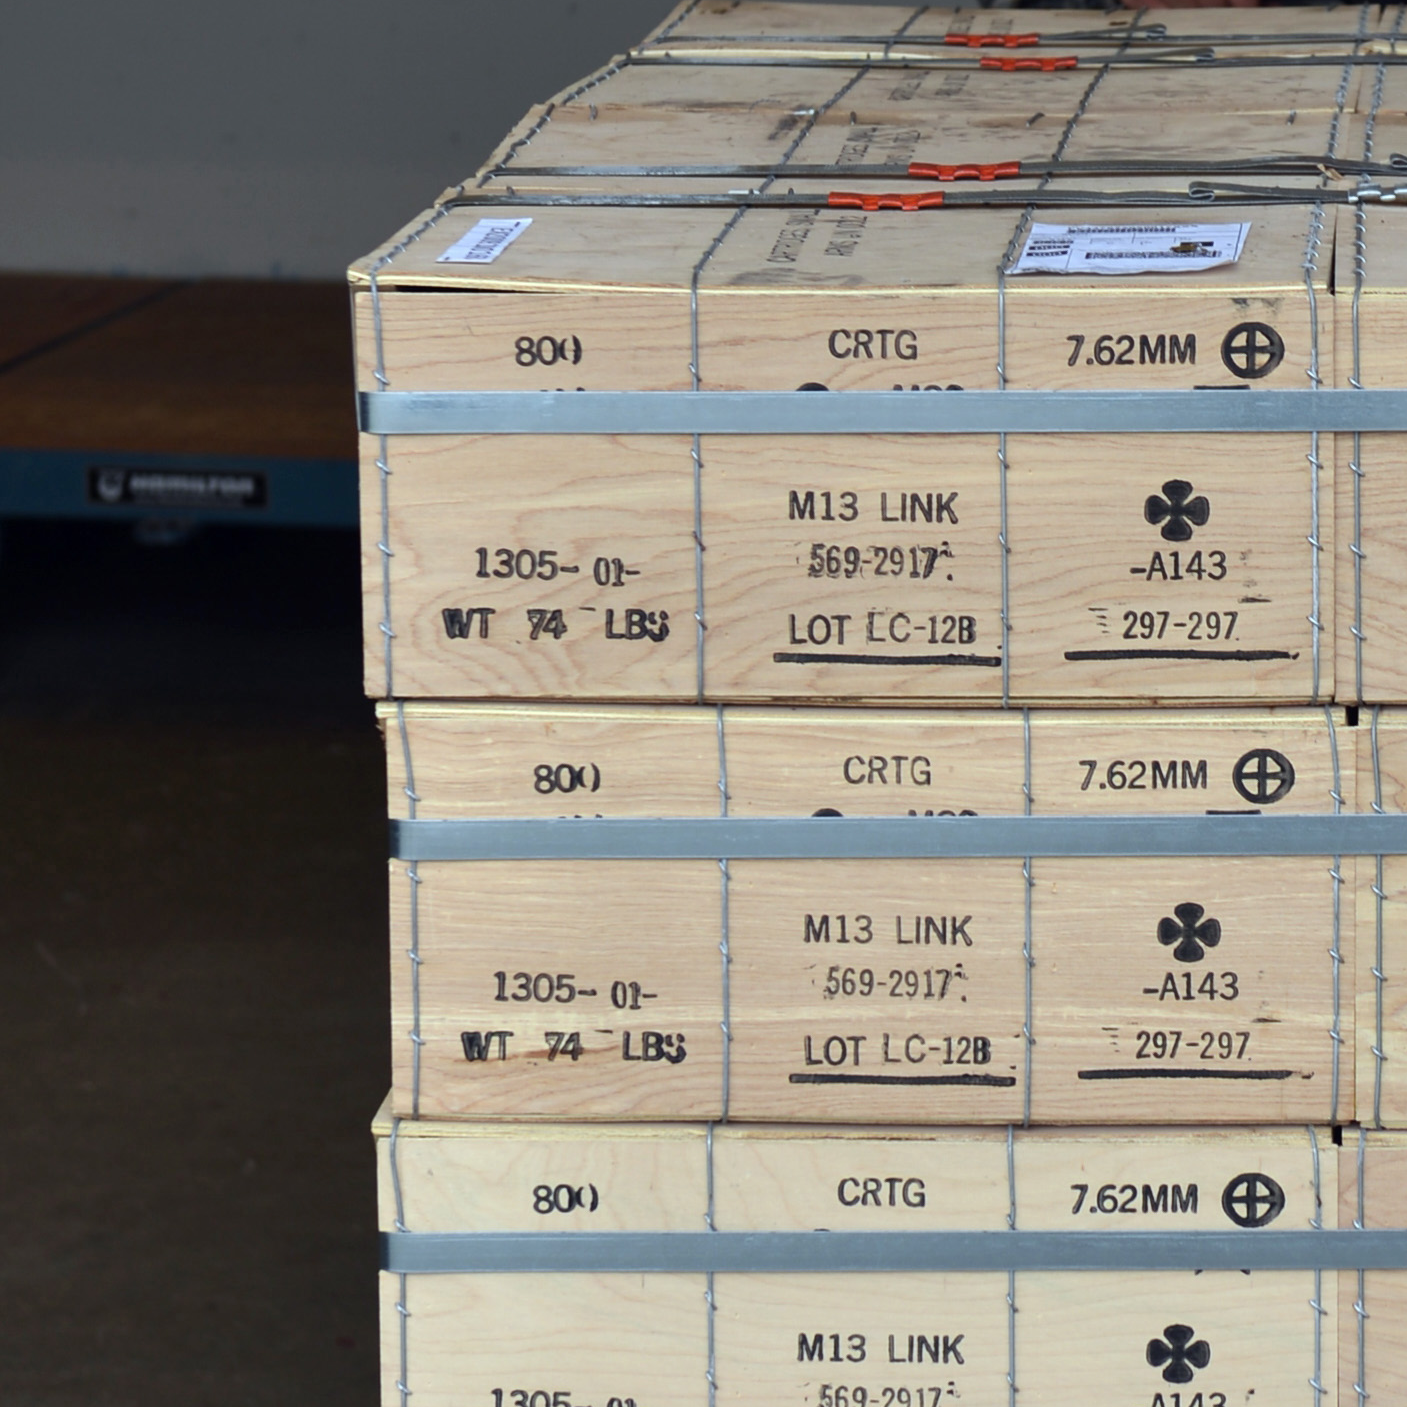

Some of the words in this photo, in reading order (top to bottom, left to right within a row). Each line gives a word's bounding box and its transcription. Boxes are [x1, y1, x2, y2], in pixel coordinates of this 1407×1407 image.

[515, 335, 582, 366] 800
[829, 329, 917, 360] CRTG
[1067, 334, 1196, 366] 7.62MM
[789, 490, 858, 521] M13
[881, 492, 958, 524] LINK
[442, 608, 496, 639] WT
[527, 609, 567, 640] 74
[790, 614, 851, 645] LOT
[866, 612, 976, 644] LC-12B
[1123, 611, 1238, 640] 297-297
[534, 763, 600, 794] 800
[844, 756, 931, 785] CRTG
[1079, 760, 1207, 790] 7.62MM
[804, 914, 873, 944] M13
[897, 916, 972, 946] LINK
[461, 1031, 514, 1063] WT
[545, 1032, 581, 1061] 74
[805, 1036, 866, 1066] LOT
[883, 1033, 991, 1064] LC-12B
[1136, 1031, 1250, 1059] 297-297
[533, 1184, 598, 1214] 800
[838, 1178, 925, 1207] CRTG
[1071, 1184, 1198, 1214] 7.62MM
[797, 1333, 866, 1362] M13
[889, 1334, 964, 1364] LINK
